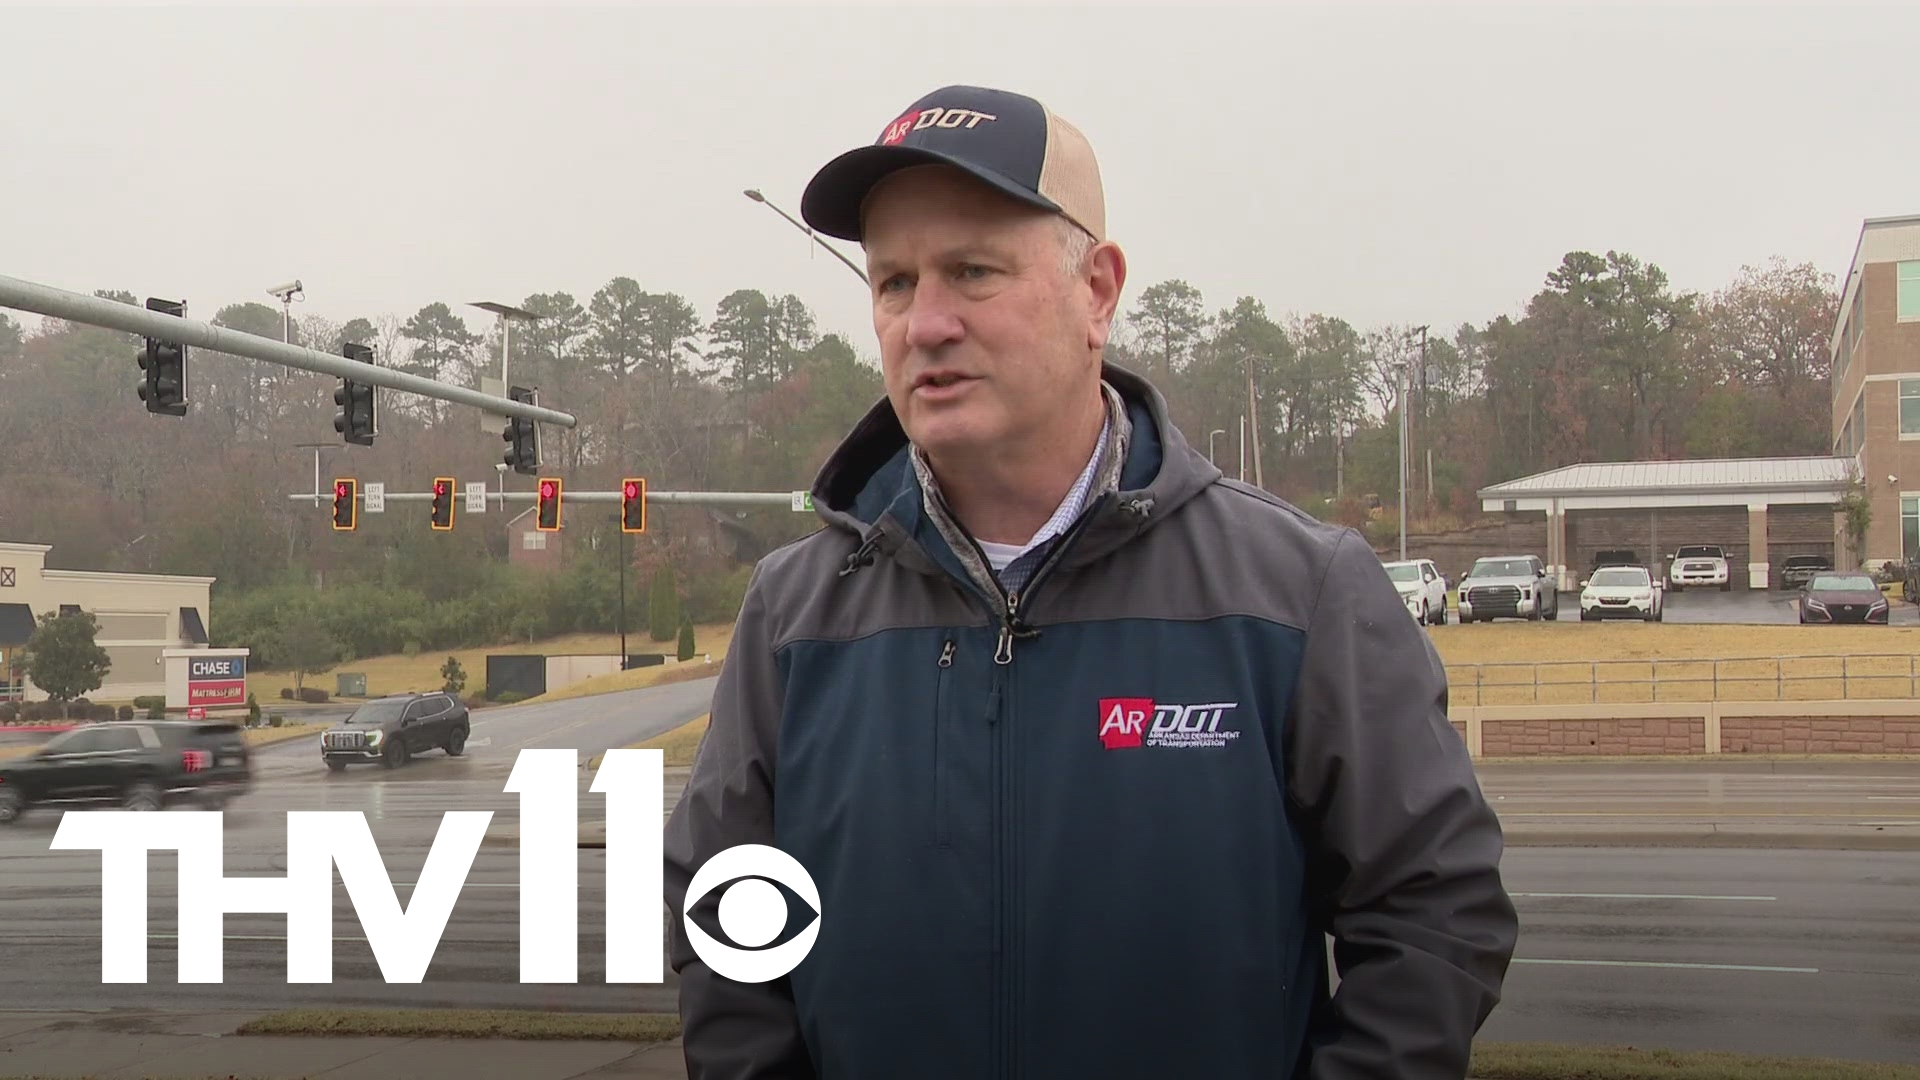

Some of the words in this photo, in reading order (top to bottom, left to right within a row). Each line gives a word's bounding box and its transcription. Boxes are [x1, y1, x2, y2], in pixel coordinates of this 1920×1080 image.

[192, 661, 231, 676] CHASE
[1147, 731, 1190, 740] ARKANSAS
[1191, 731, 1241, 741] DEPARTMENT
[1146, 739, 1158, 747] OF
[1158, 739, 1226, 748] TRANSPORTATION
